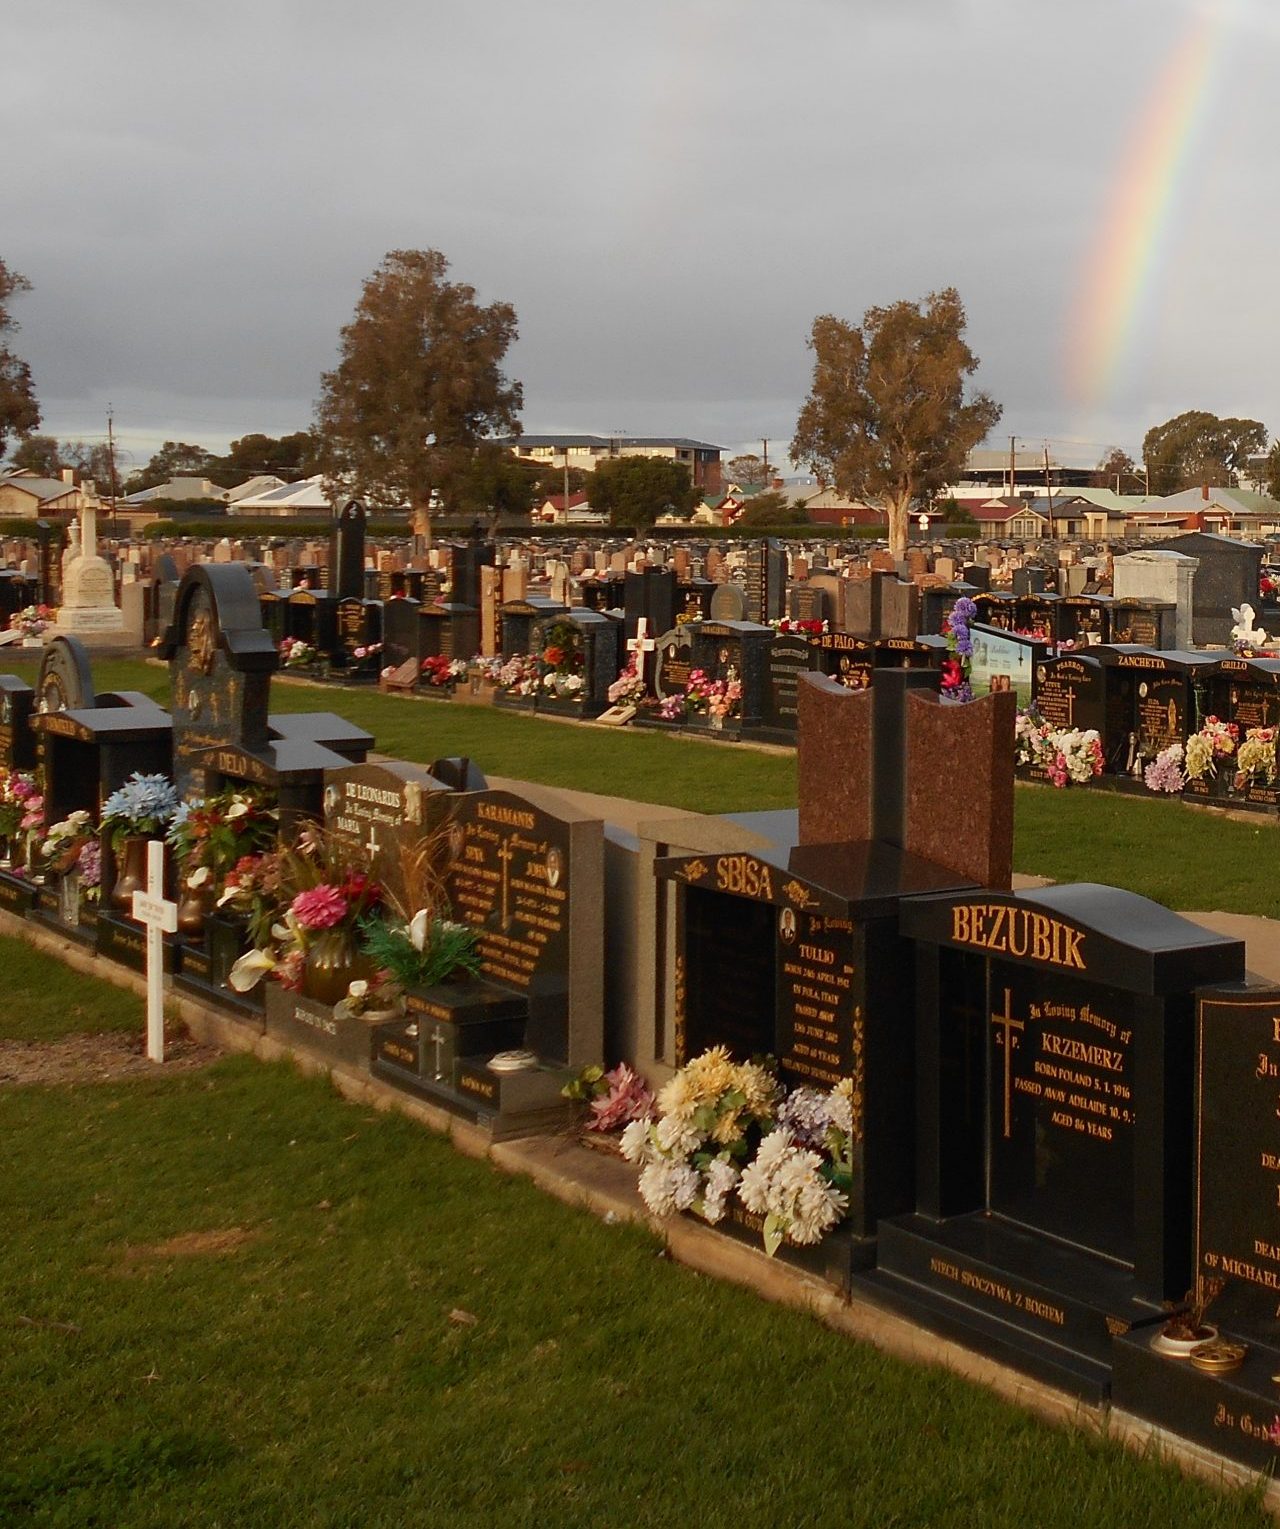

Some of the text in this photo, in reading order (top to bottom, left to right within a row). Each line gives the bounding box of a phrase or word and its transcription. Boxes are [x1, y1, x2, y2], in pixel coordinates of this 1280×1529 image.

[822, 634, 855, 650] DE PALO
[1118, 656, 1166, 669] ZANCHETTA
[1221, 660, 1248, 670] GRILLO
[345, 782, 400, 809] DE LEONARDIS
[478, 802, 535, 830] KARAMANIS
[717, 856, 773, 900] SBISA
[952, 905, 1086, 969] BEZUBIK
[799, 944, 835, 965] TULLIO
[1029, 1001, 1132, 1045] In Loving Memory of
[1042, 1032, 1124, 1072] KRZEMERZ
[1034, 1060, 1058, 1078] BORN
[1058, 1068, 1092, 1088] POLAND
[1113, 1083, 1130, 1100] 1916
[1255, 1053, 1278, 1080] In
[1014, 1077, 1042, 1096] PASSED
[1044, 1087, 1066, 1103] AWAY
[1068, 1094, 1107, 1116] ADELAIDE
[1051, 1111, 1073, 1128] AGED
[1087, 1121, 1113, 1140] YEARS
[1204, 1251, 1220, 1267] OF
[930, 1257, 959, 1281] NIECH
[961, 1270, 1012, 1304] SPOCZYWA
[1025, 1296, 1065, 1325] BOGIEM
